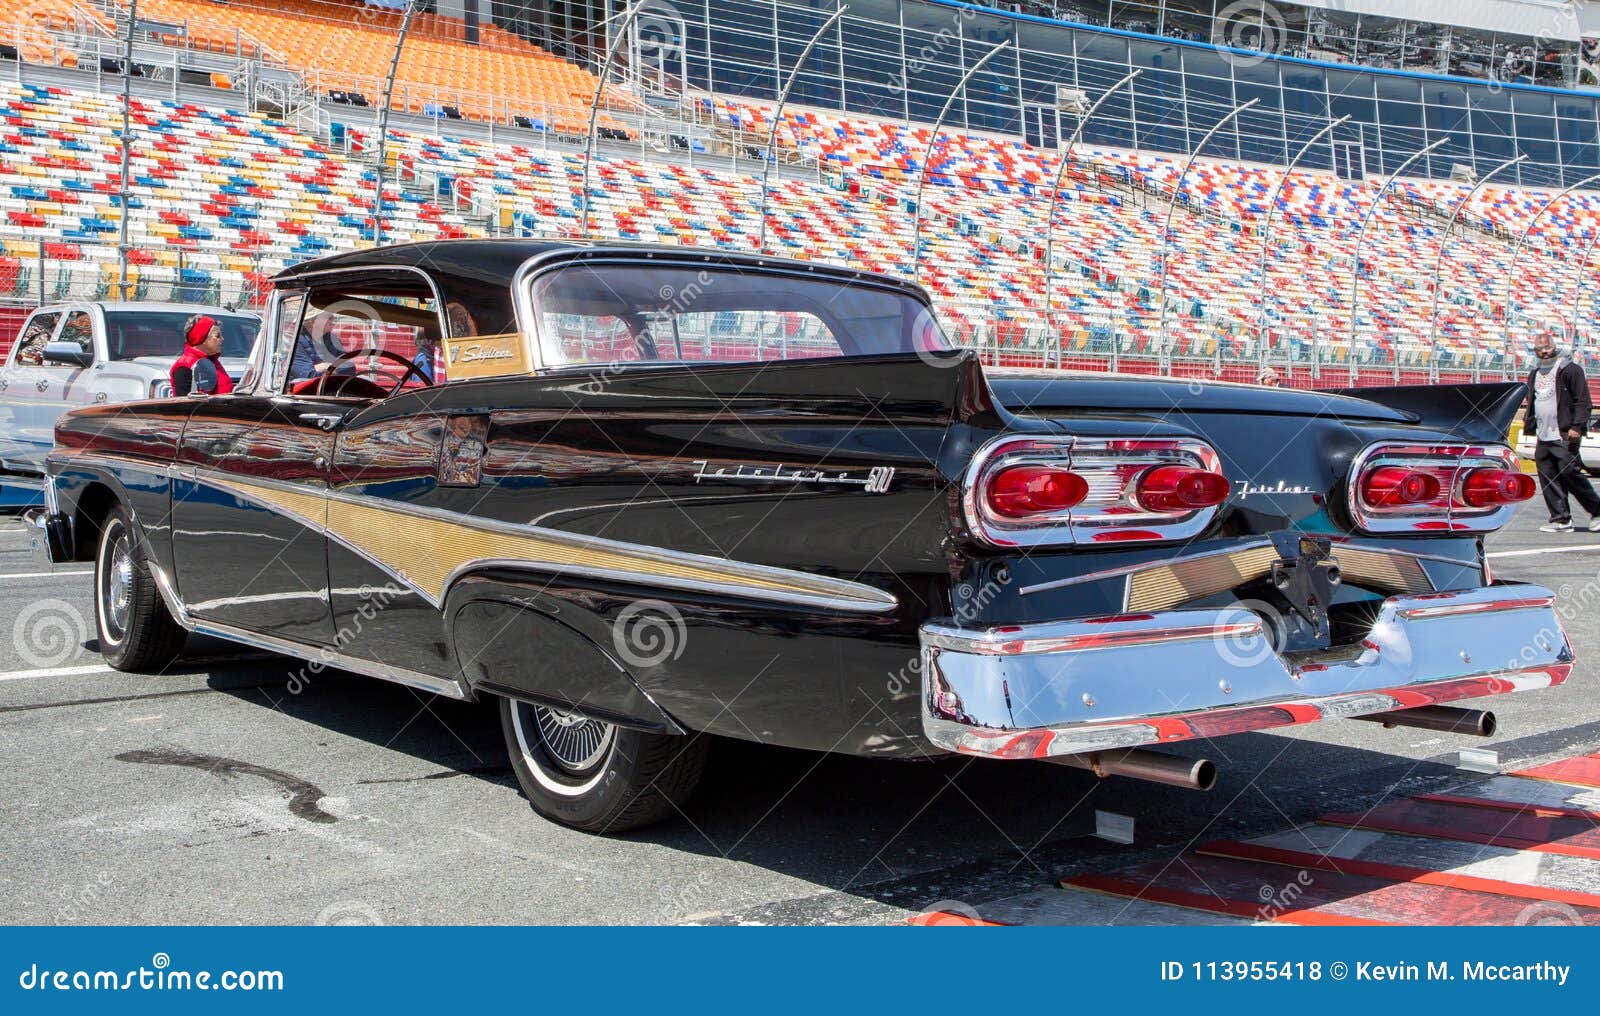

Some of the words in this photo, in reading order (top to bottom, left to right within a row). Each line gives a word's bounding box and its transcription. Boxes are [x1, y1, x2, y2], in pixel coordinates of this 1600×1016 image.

[693, 460, 852, 484] Fairlane
[864, 466, 895, 494] 500
[1235, 480, 1316, 500] Fairlane
